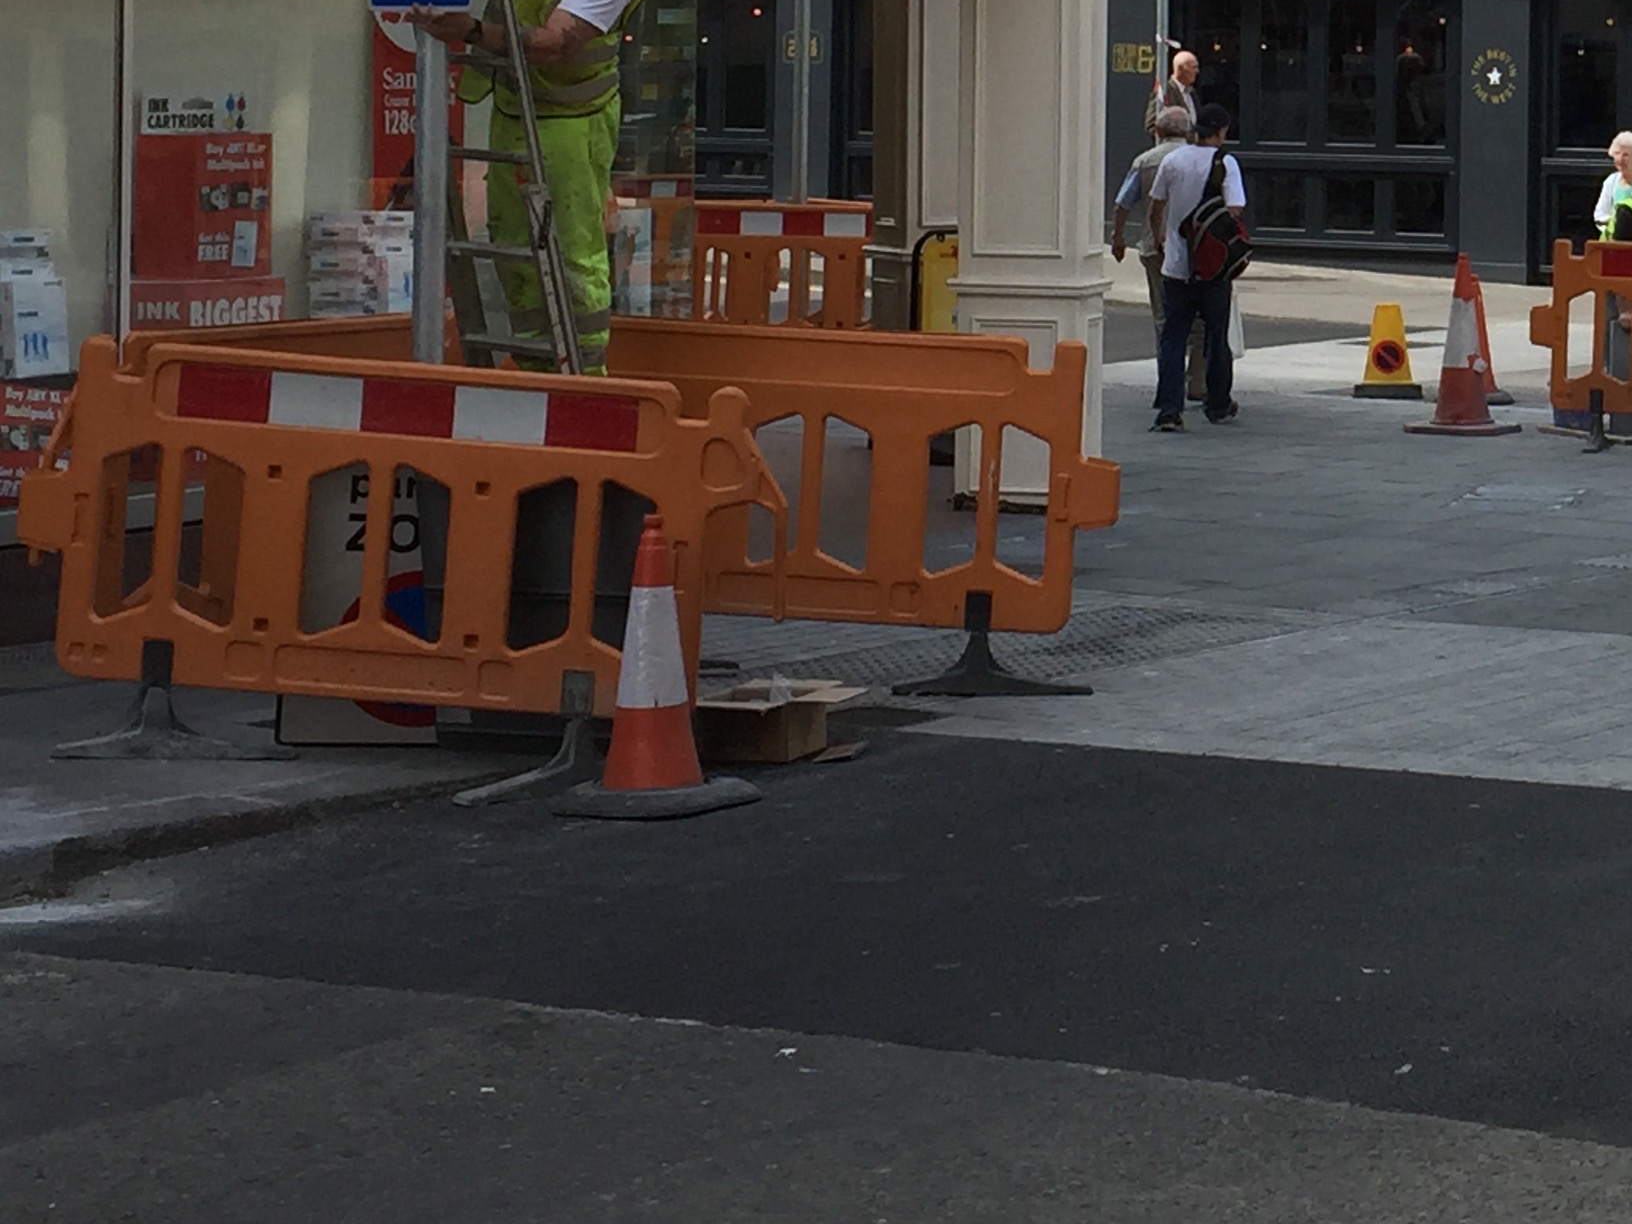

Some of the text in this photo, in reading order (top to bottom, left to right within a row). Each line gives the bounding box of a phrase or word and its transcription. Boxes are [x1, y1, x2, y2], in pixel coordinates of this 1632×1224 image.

[148, 97, 169, 113] INK
[147, 113, 215, 129] CARTRIDGE
[198, 244, 229, 262] FREE
[136, 294, 282, 326] INK BIGGEST
